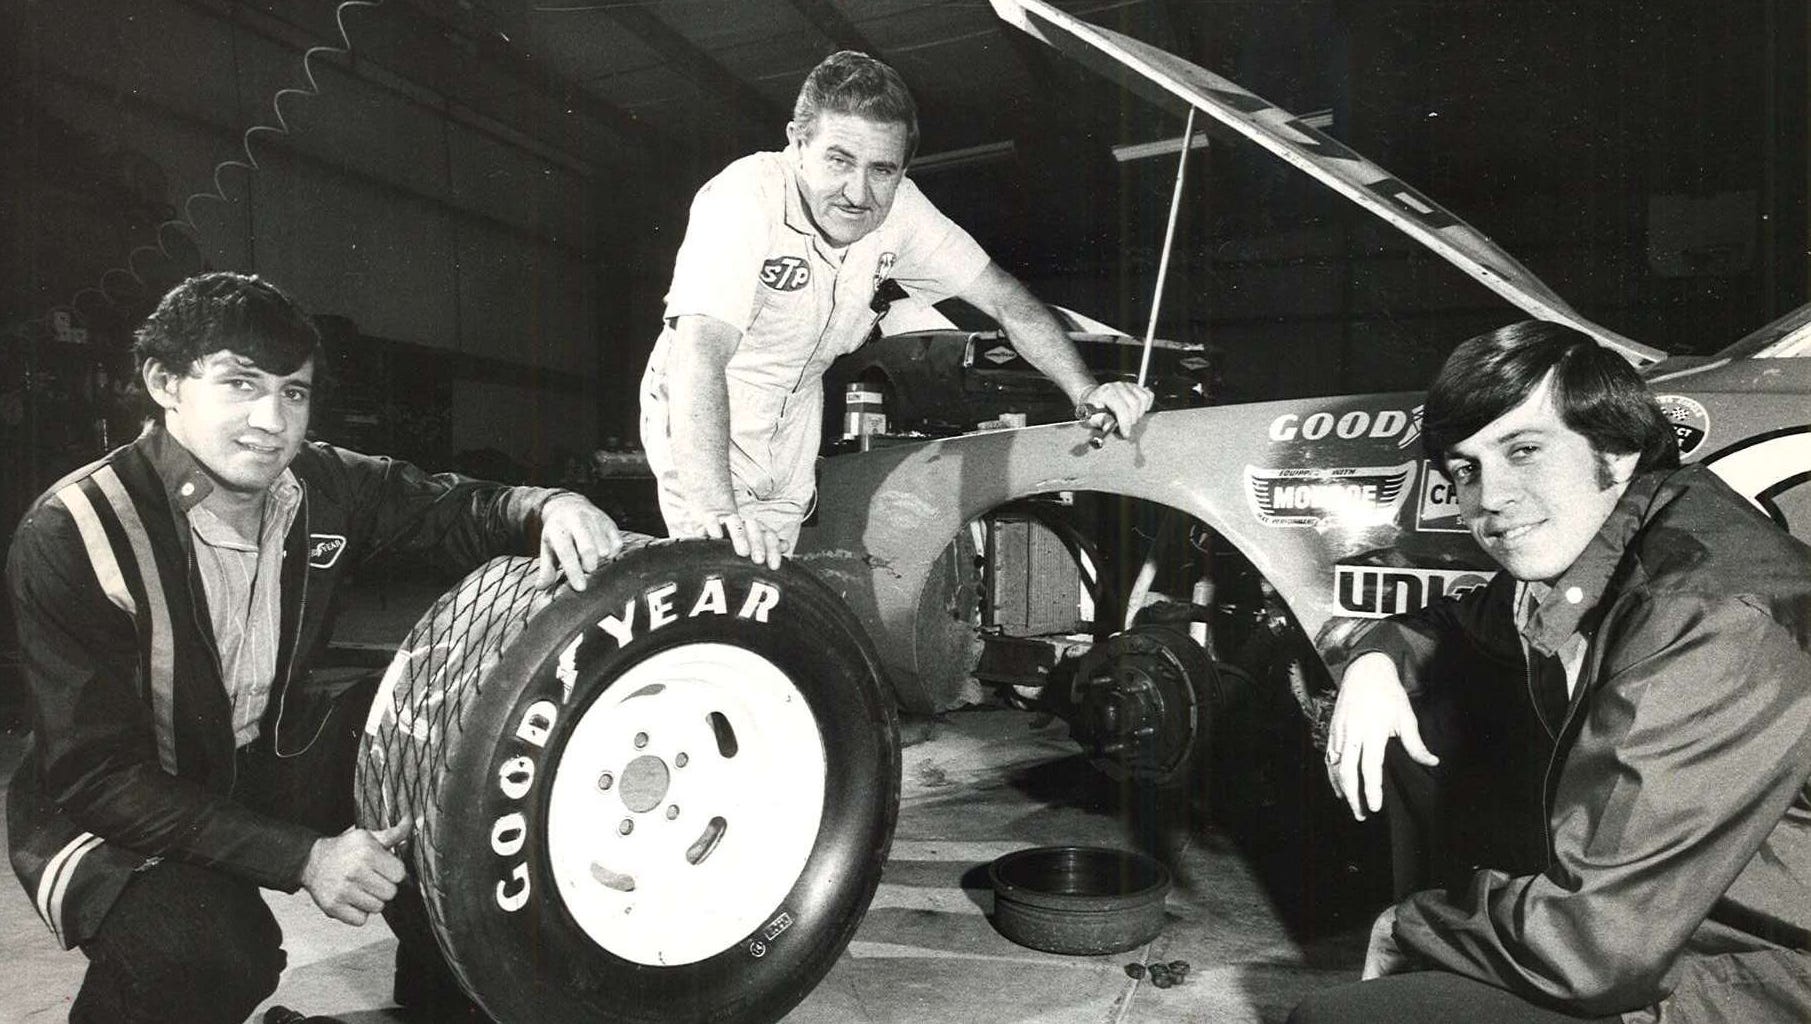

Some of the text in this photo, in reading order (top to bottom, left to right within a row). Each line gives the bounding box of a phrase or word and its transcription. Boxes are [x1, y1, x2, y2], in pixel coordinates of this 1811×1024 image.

[763, 258, 808, 289] STP
[1273, 484, 1377, 510] MOOE
[1339, 571, 1452, 614] UNI
